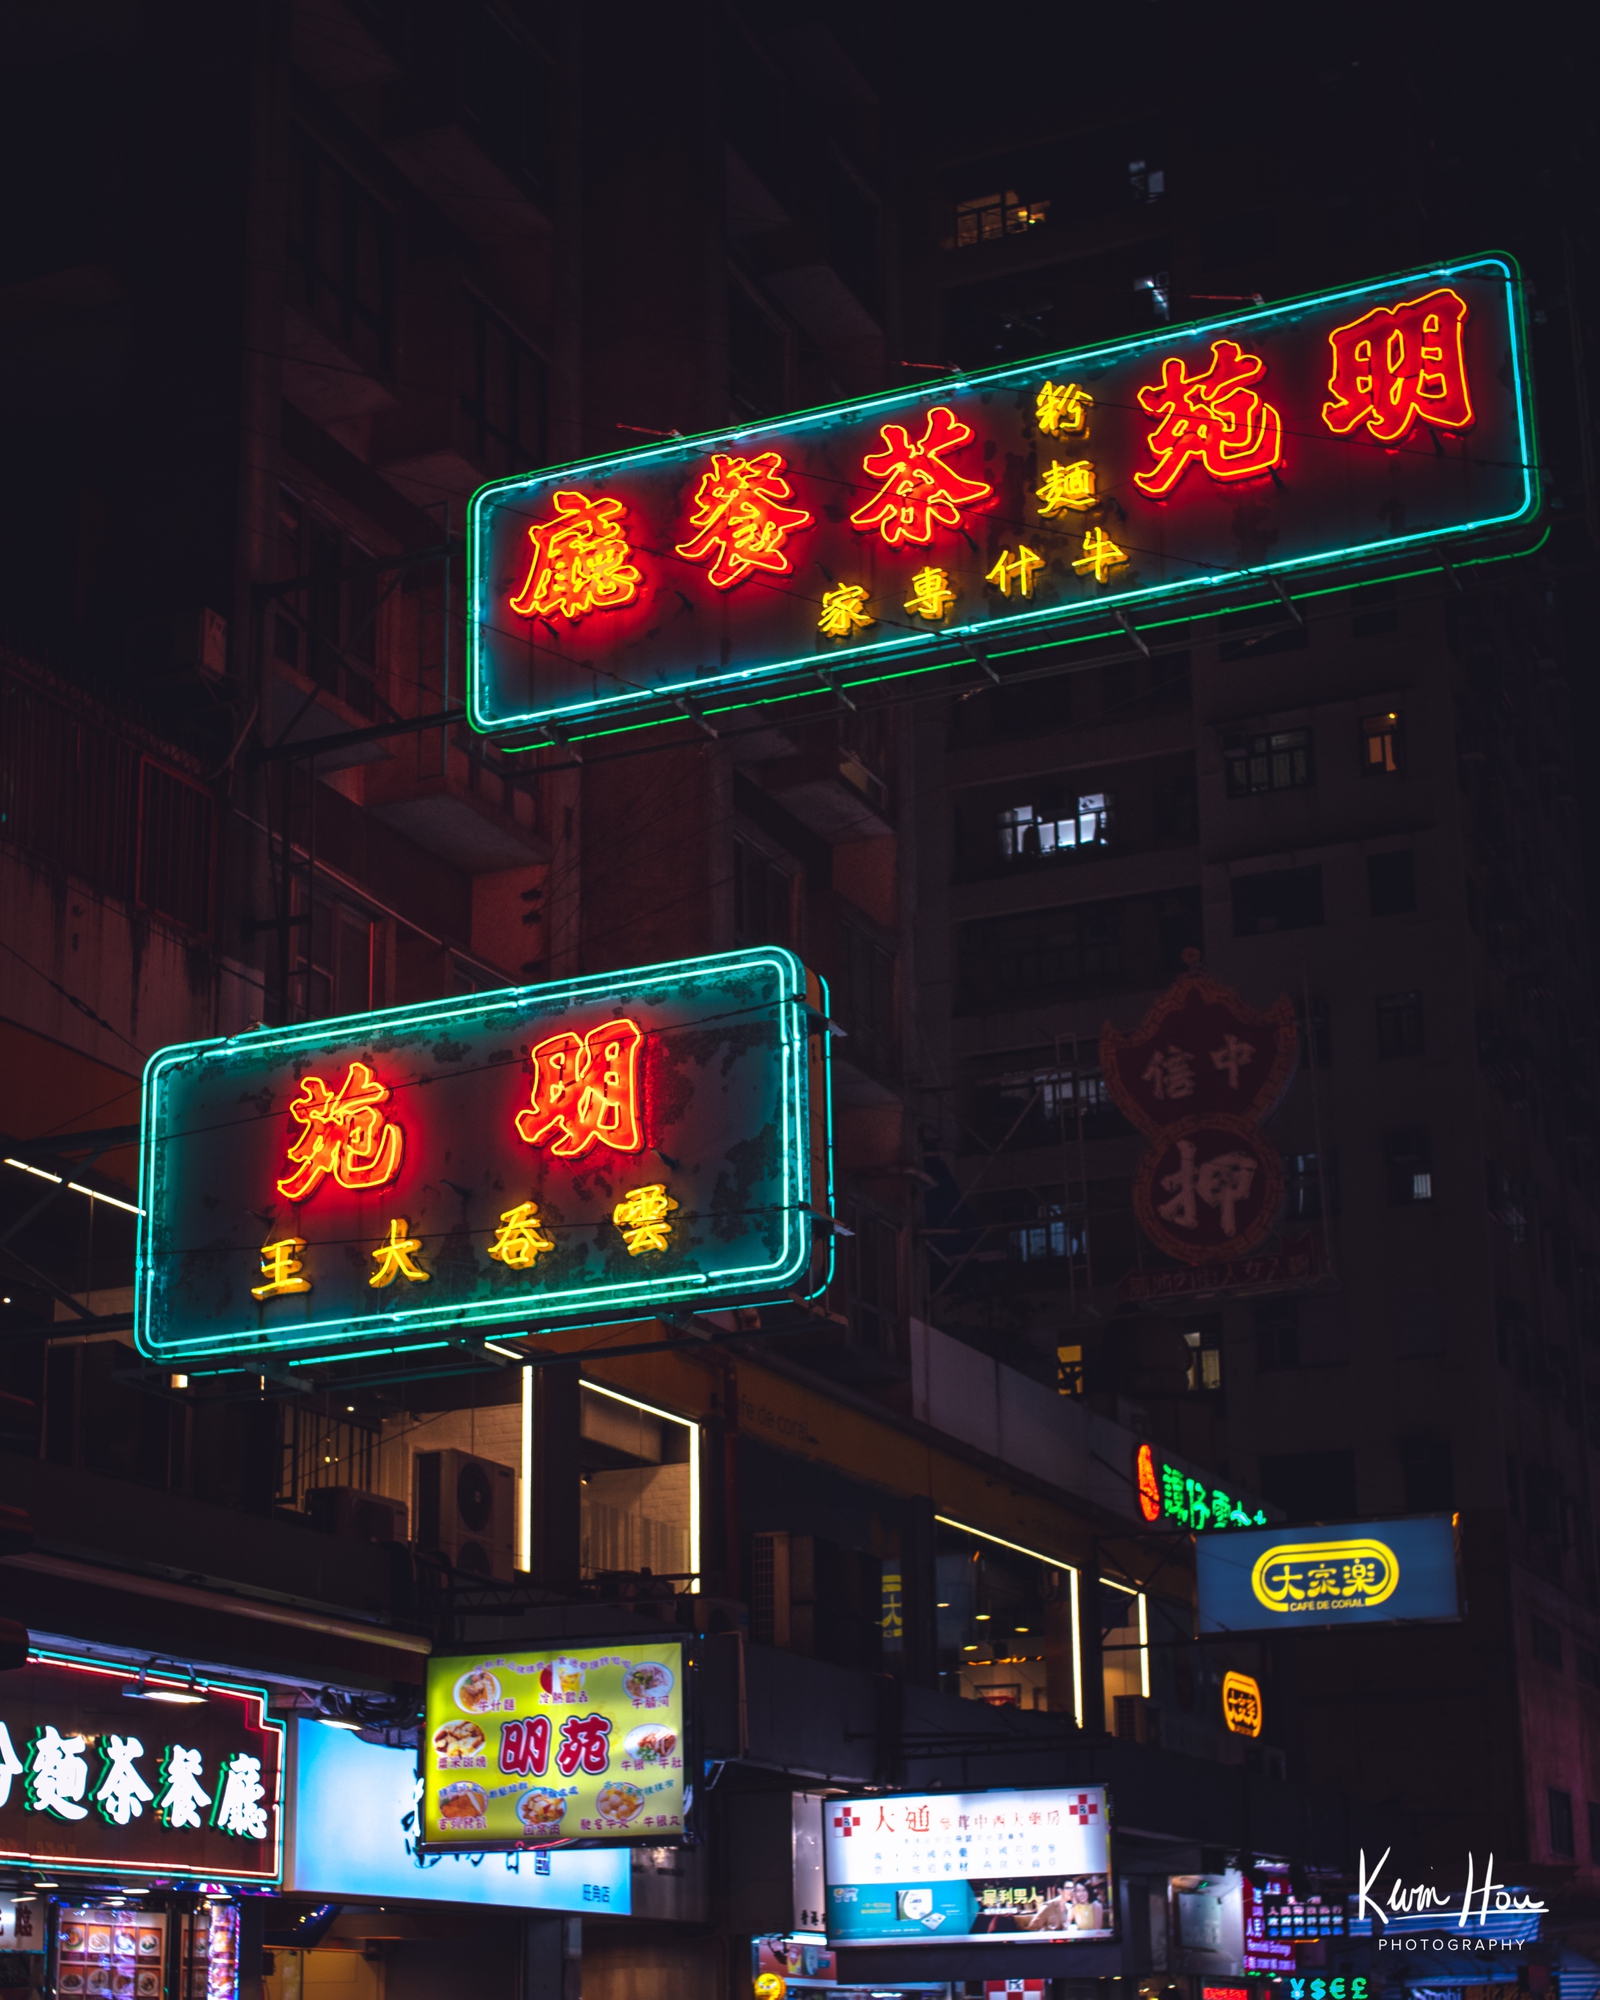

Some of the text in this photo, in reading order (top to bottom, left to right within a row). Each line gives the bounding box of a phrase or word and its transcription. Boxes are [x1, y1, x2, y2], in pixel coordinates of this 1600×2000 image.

[1035, 380, 1099, 518] 粉麵
[1135, 287, 1475, 498] 明苑
[277, 1017, 646, 1203] 明苑
[250, 1183, 678, 1300] 雲吞大王
[1157, 1139, 1259, 1238] 押
[1316, 1600, 1330, 1611] DE
[1331, 1598, 1362, 1610] CORAL
[498, 1713, 613, 1777] 明苑
